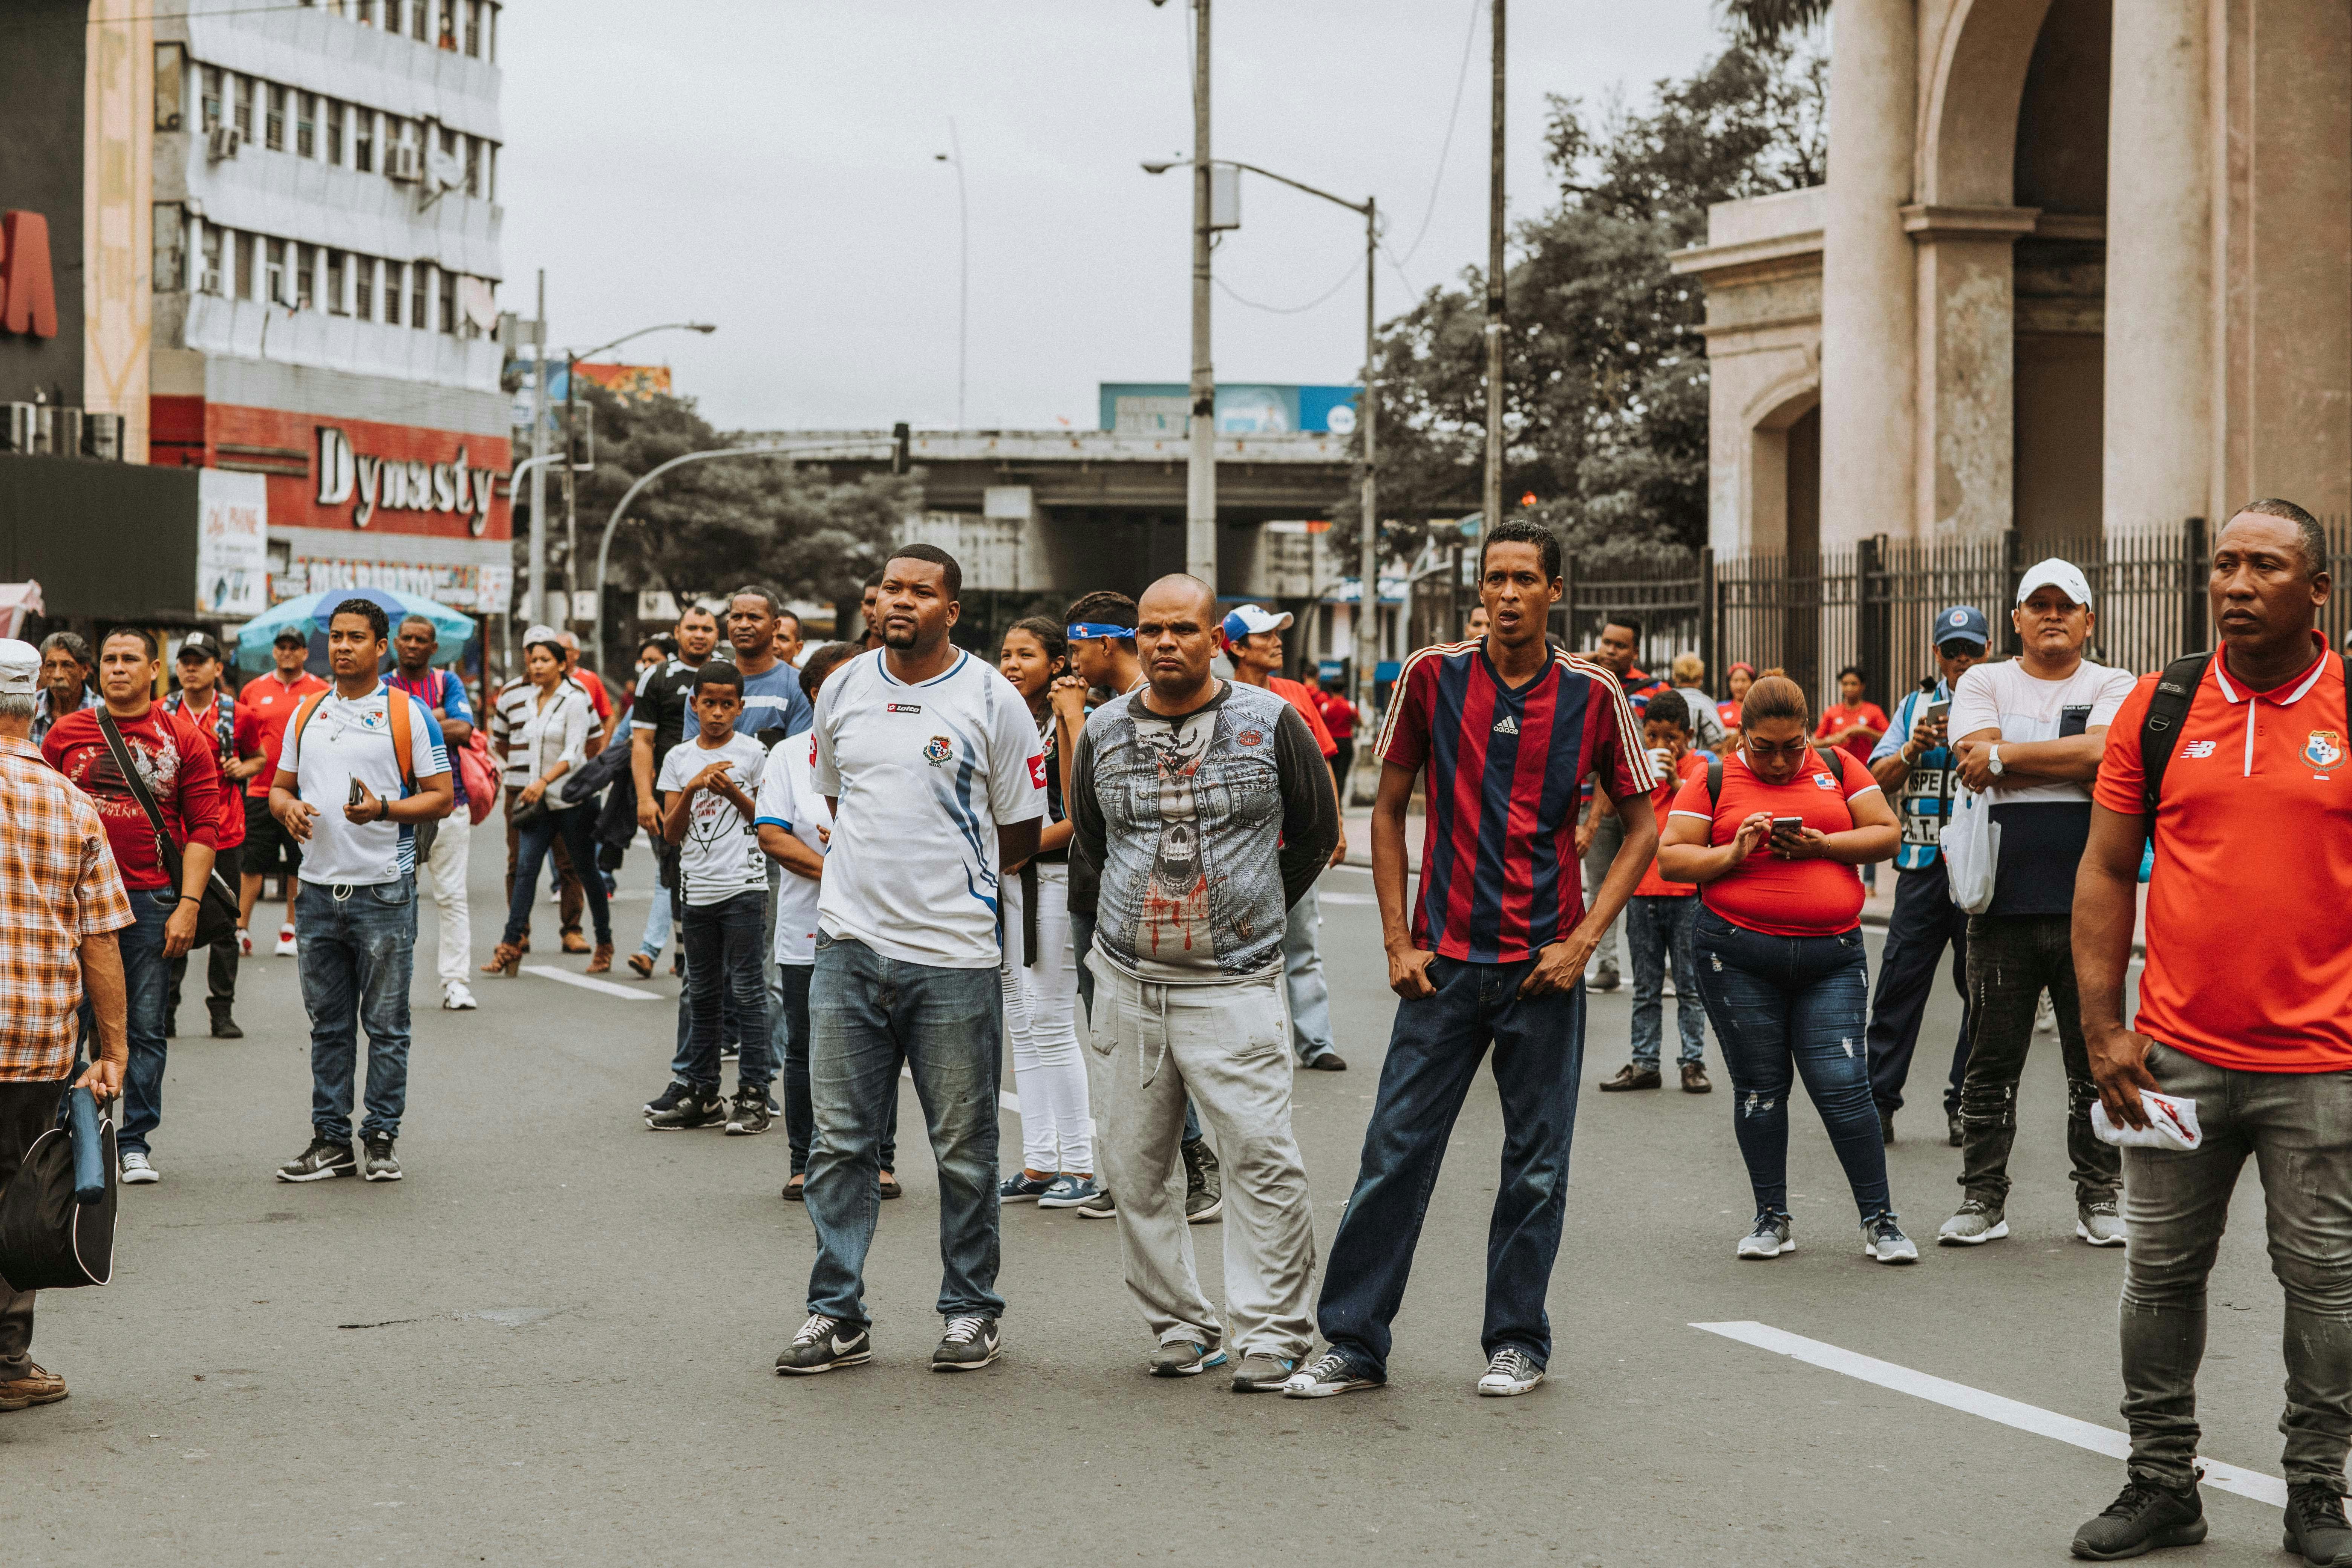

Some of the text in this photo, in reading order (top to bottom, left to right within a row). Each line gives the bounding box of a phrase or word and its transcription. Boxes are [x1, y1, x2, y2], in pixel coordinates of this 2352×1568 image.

[0, 208, 58, 338] A
[316, 426, 496, 537] Dynasty
[1493, 726, 1518, 735] adidas
